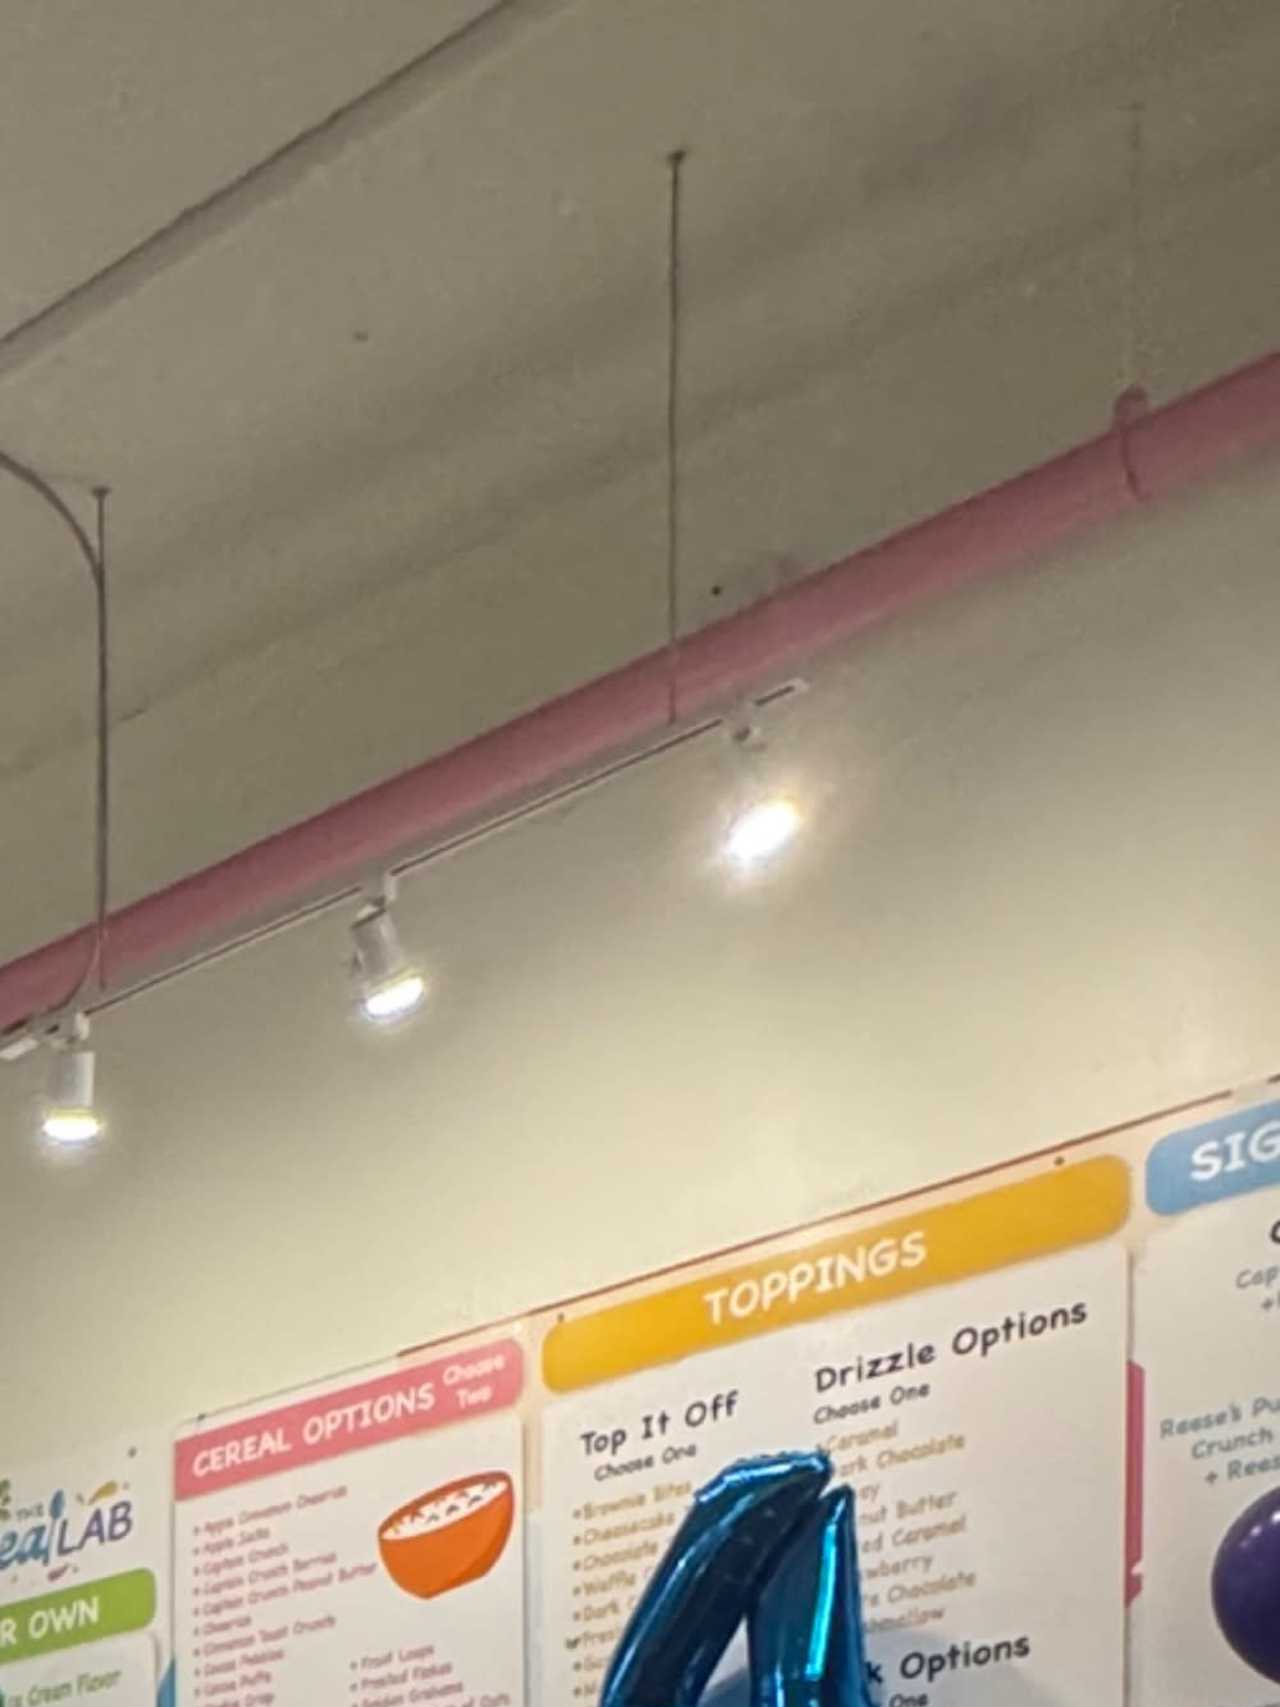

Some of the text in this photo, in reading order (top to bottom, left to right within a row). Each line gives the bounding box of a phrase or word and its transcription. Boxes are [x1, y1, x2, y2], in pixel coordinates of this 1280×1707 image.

[702, 1230, 928, 1326] TOPPINGS
[814, 1299, 1089, 1393] Drizzle Options
[443, 1354, 505, 1384] Choose
[457, 1386, 492, 1409] Two
[813, 1383, 930, 1425] Choose One
[192, 1382, 436, 1477] CEREAL OPTIONS
[581, 1389, 740, 1458] Top It Off
[1160, 1403, 1242, 1439] Reese's
[594, 1444, 697, 1482] Choose One
[877, 1433, 965, 1469] Chocolate
[1191, 1427, 1274, 1461] Crunch
[56, 1501, 134, 1556] LAB
[891, 1513, 966, 1548] Caramel
[888, 1572, 976, 1604] Chocolate
[28, 1596, 100, 1640] OWN
[899, 1635, 1031, 1683] Options
